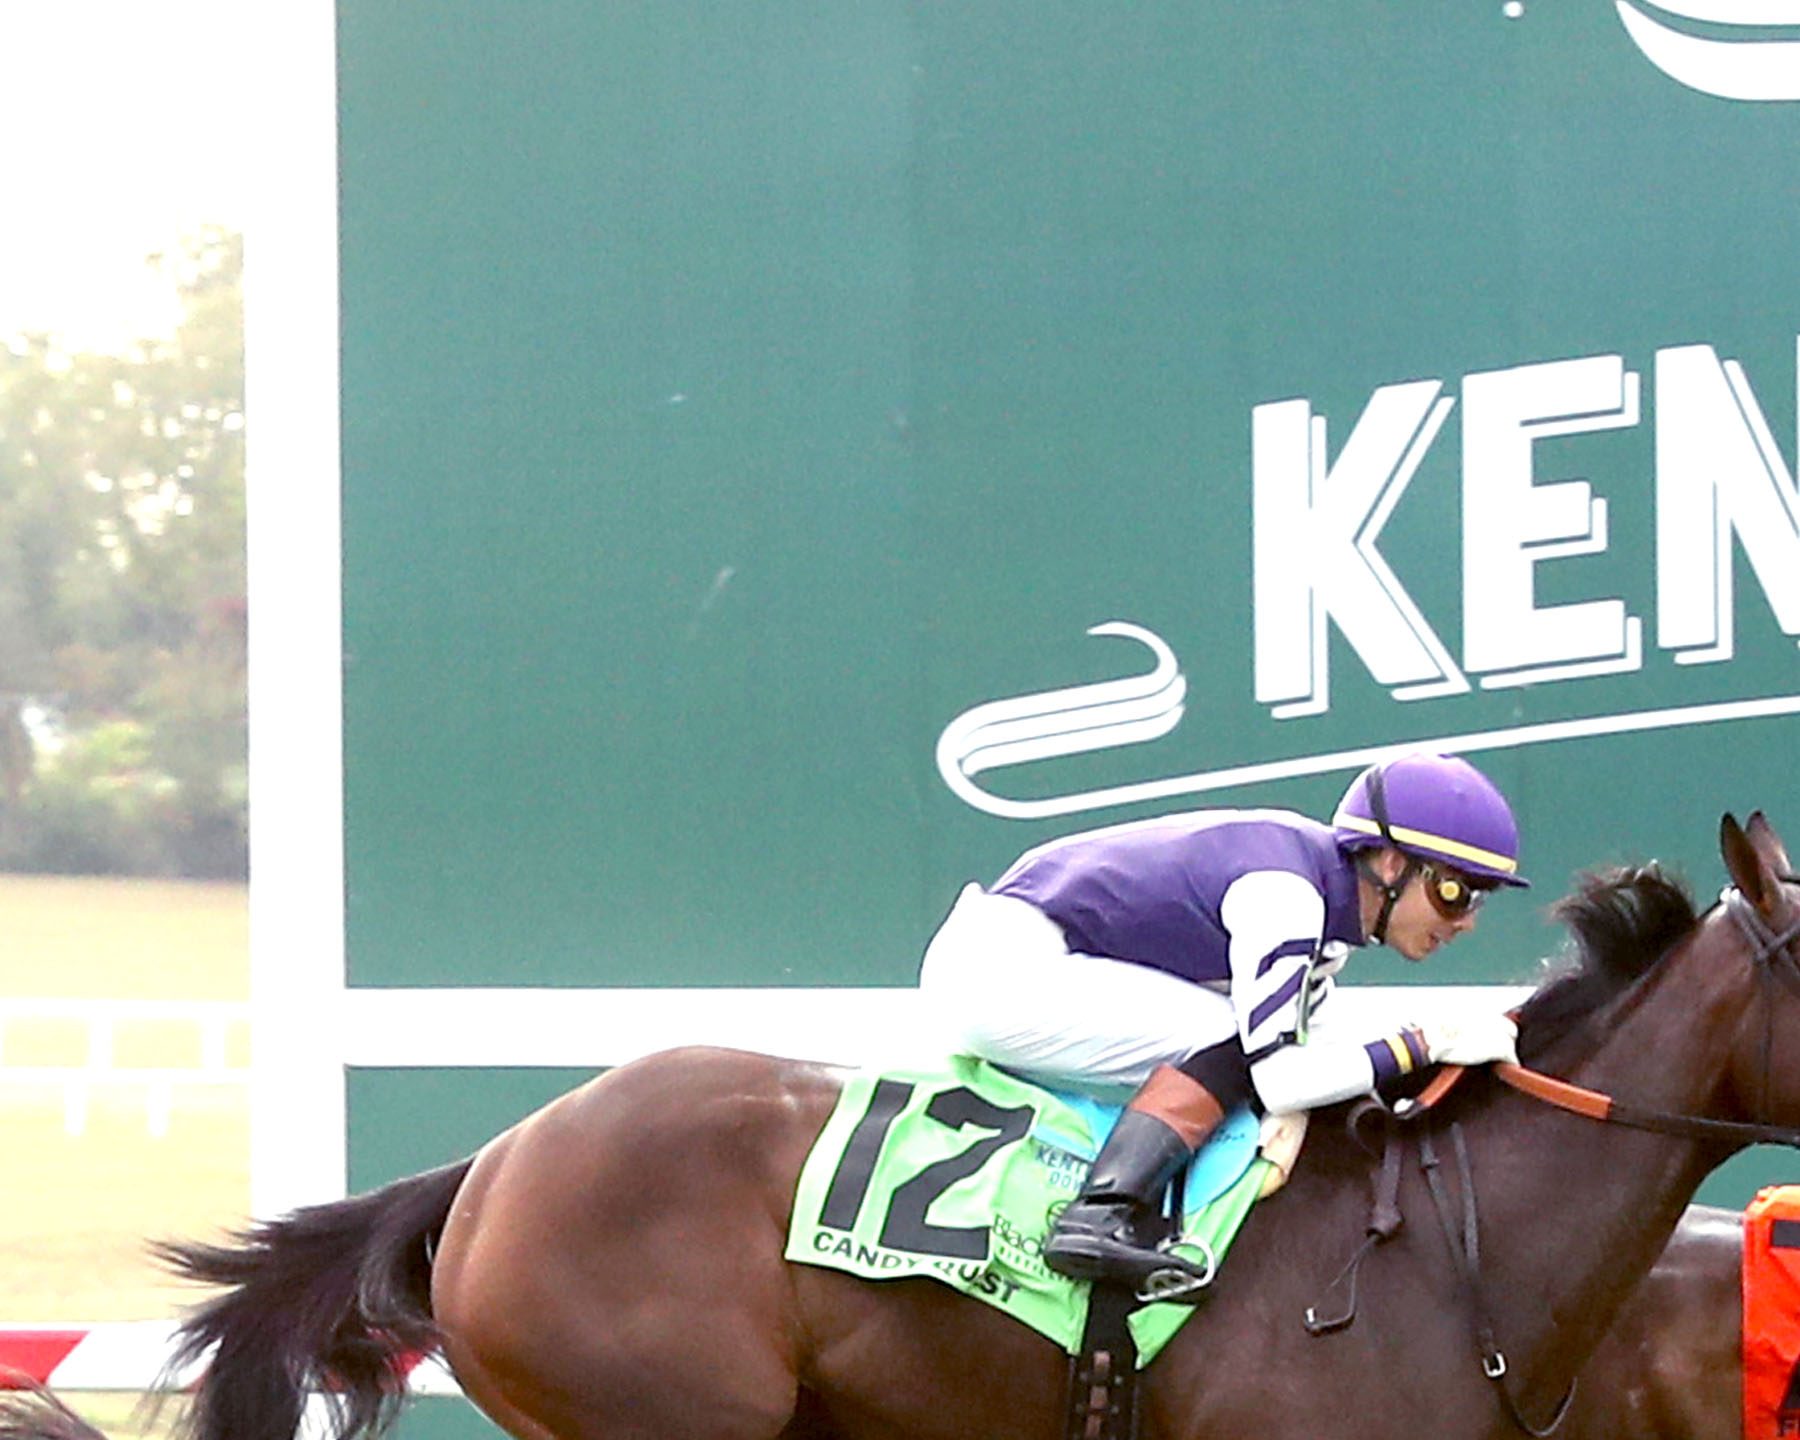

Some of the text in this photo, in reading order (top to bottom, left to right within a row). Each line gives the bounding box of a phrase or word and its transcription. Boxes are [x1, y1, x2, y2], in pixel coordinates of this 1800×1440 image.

[817, 1078, 1036, 1261] 12
[813, 1231, 924, 1269] CANDY
[933, 1260, 1021, 1303] QUST
